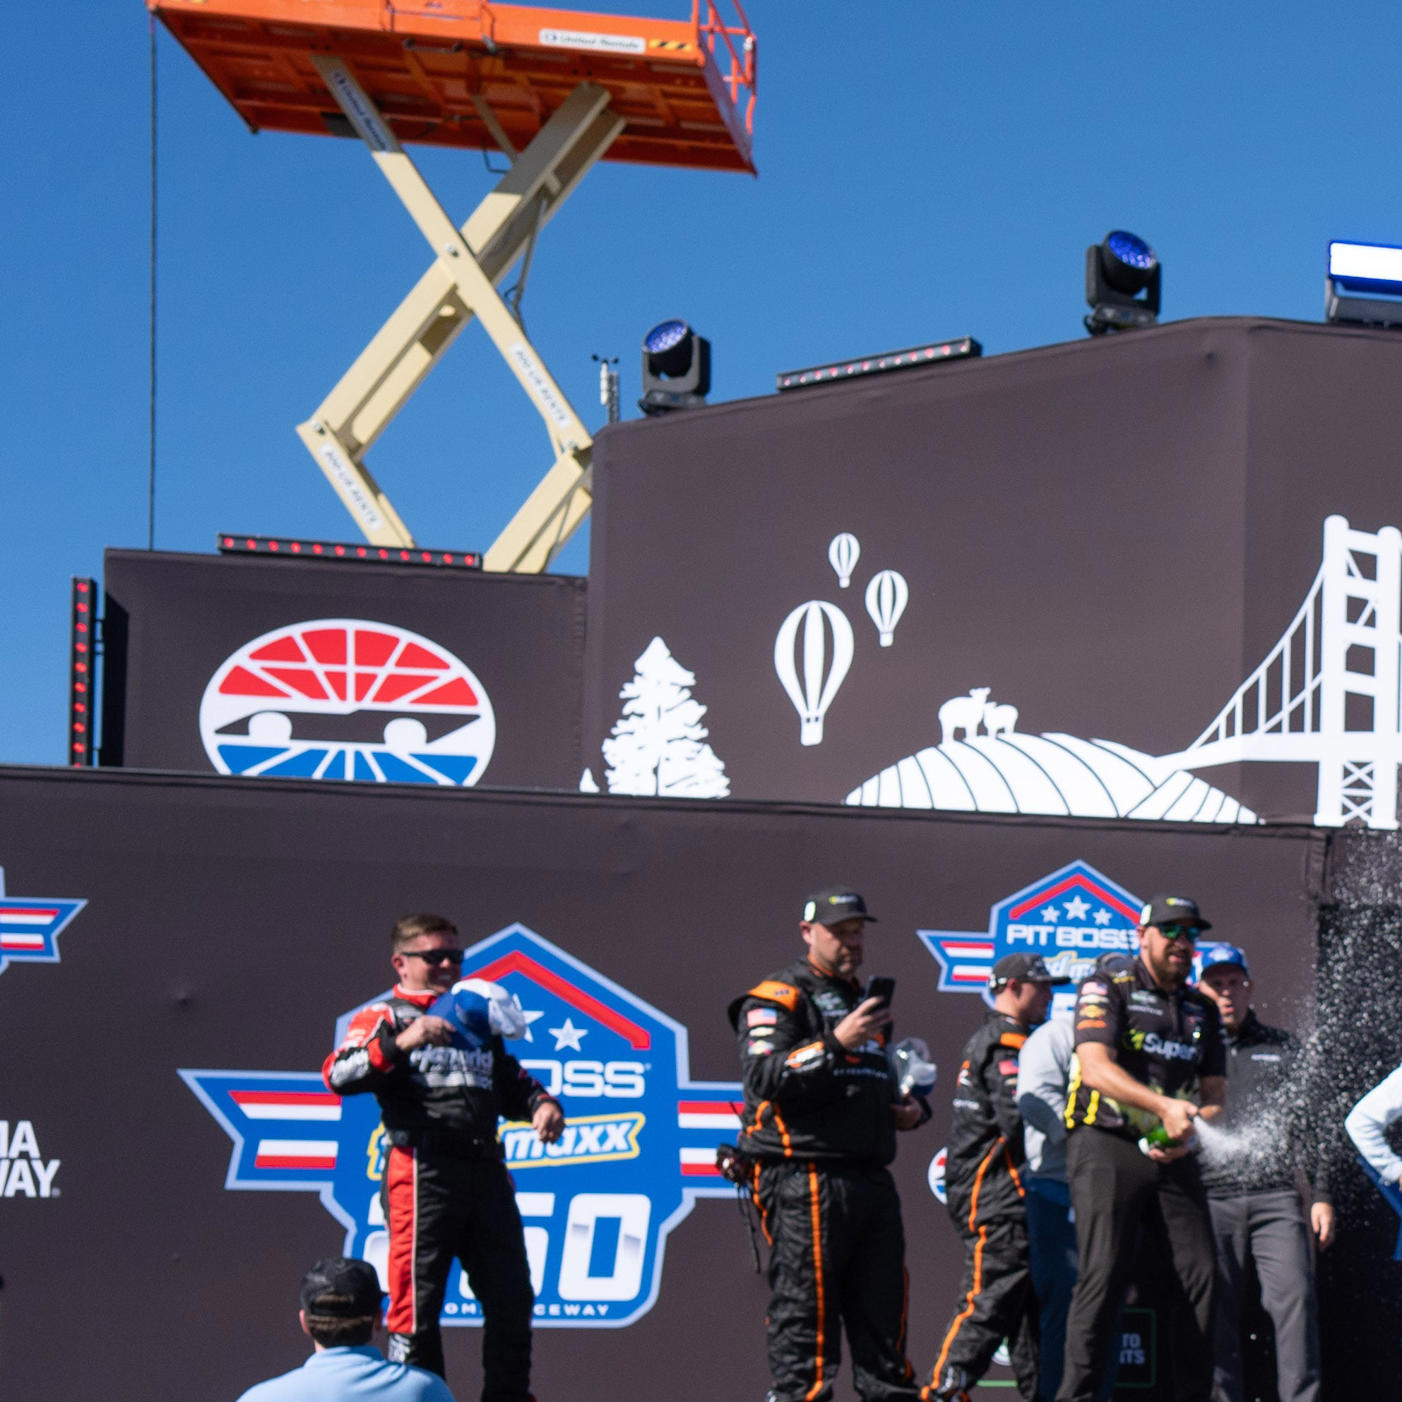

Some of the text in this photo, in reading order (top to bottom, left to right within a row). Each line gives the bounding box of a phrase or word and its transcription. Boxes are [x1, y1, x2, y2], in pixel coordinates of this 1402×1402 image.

[1007, 924, 1140, 950] PIT BOSS
[533, 1304, 610, 1316] CEWAY
